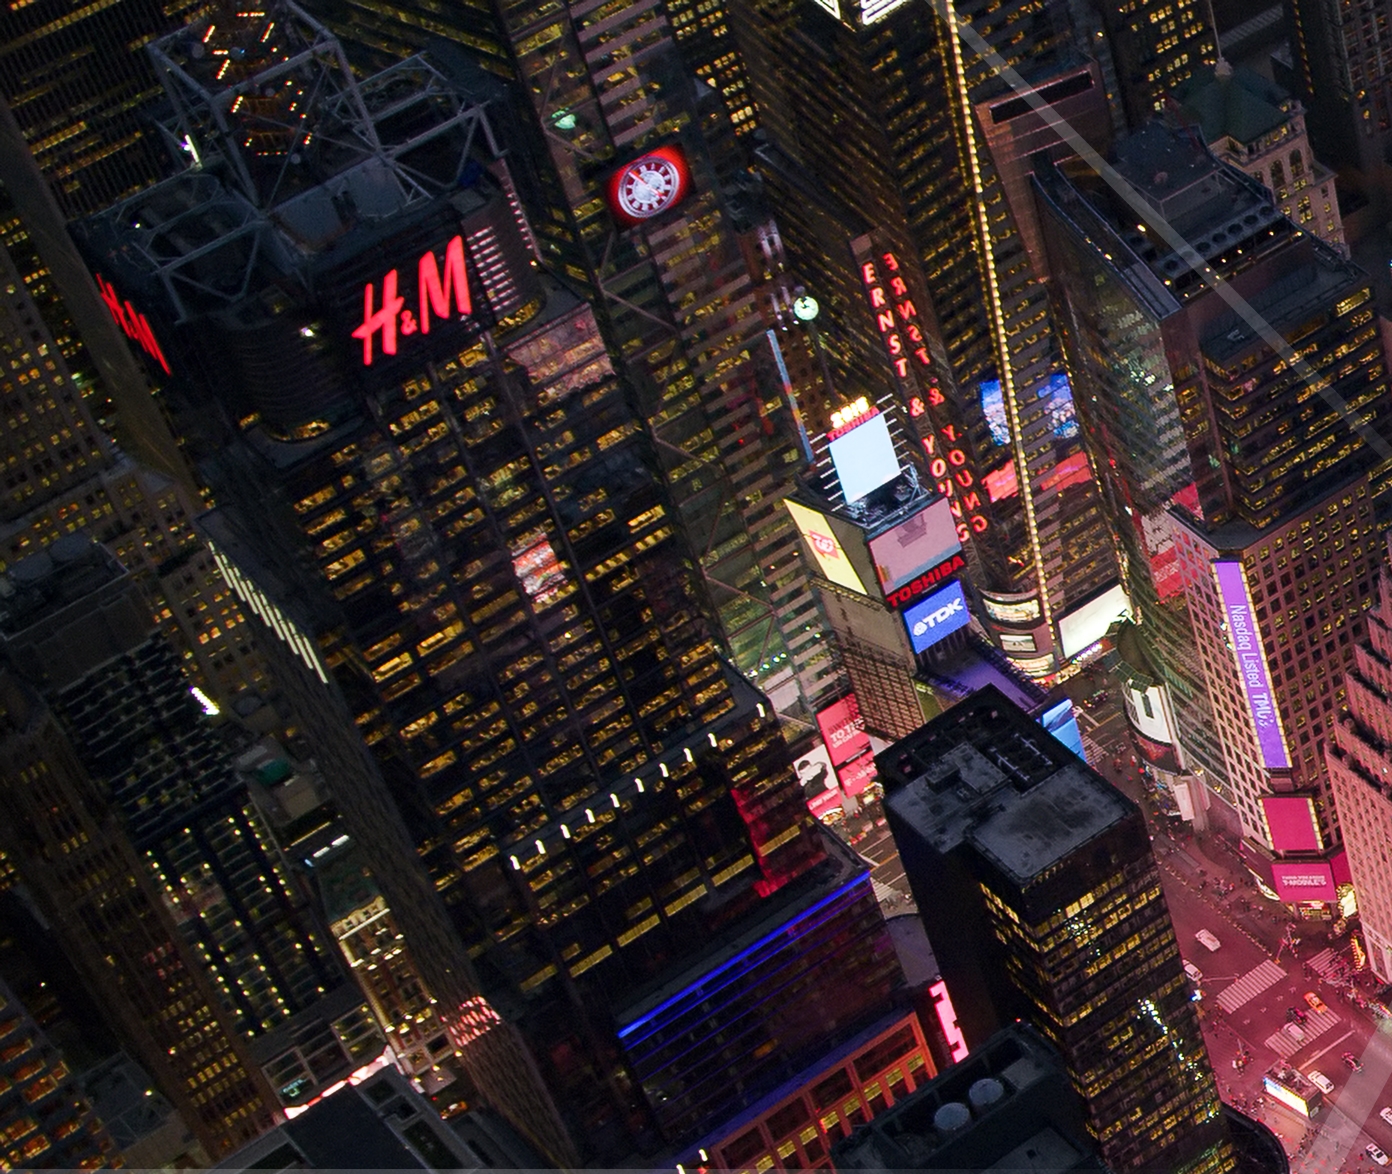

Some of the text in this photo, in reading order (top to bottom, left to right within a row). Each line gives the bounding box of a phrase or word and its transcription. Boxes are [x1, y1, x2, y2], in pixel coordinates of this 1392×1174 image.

[351, 234, 472, 366] H&M
[862, 262, 970, 543] ERNST & YOUNG
[886, 555, 965, 608] TOSHIBA
[924, 597, 964, 629] TDK
[1229, 604, 1253, 651] Nasdaq
[1241, 652, 1264, 688] Listed
